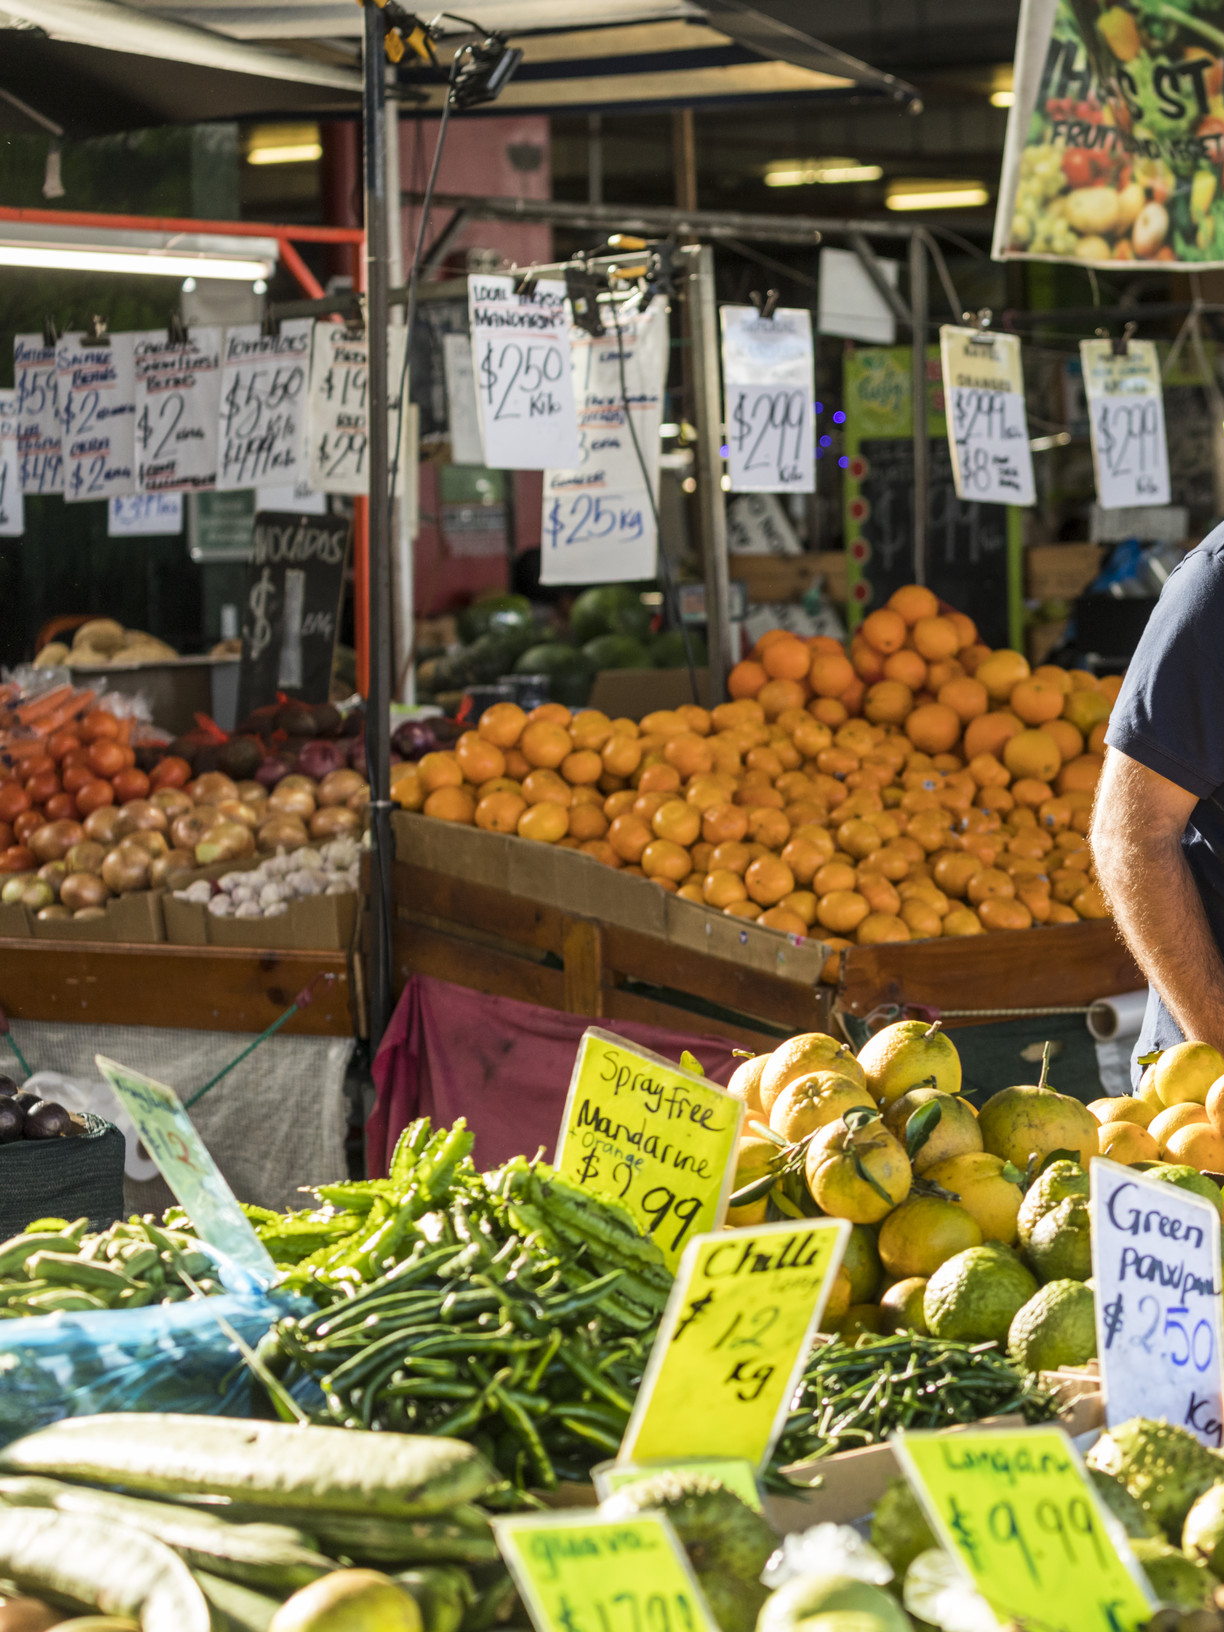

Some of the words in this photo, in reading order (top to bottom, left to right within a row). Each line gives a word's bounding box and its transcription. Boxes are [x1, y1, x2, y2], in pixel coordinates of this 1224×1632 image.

[600, 1050, 664, 1114] Spray
[664, 1086, 727, 1132] Free
[577, 1098, 712, 1179] Mandarine
[582, 1131, 645, 1172] Orange
[1107, 1181, 1205, 1249] Green
